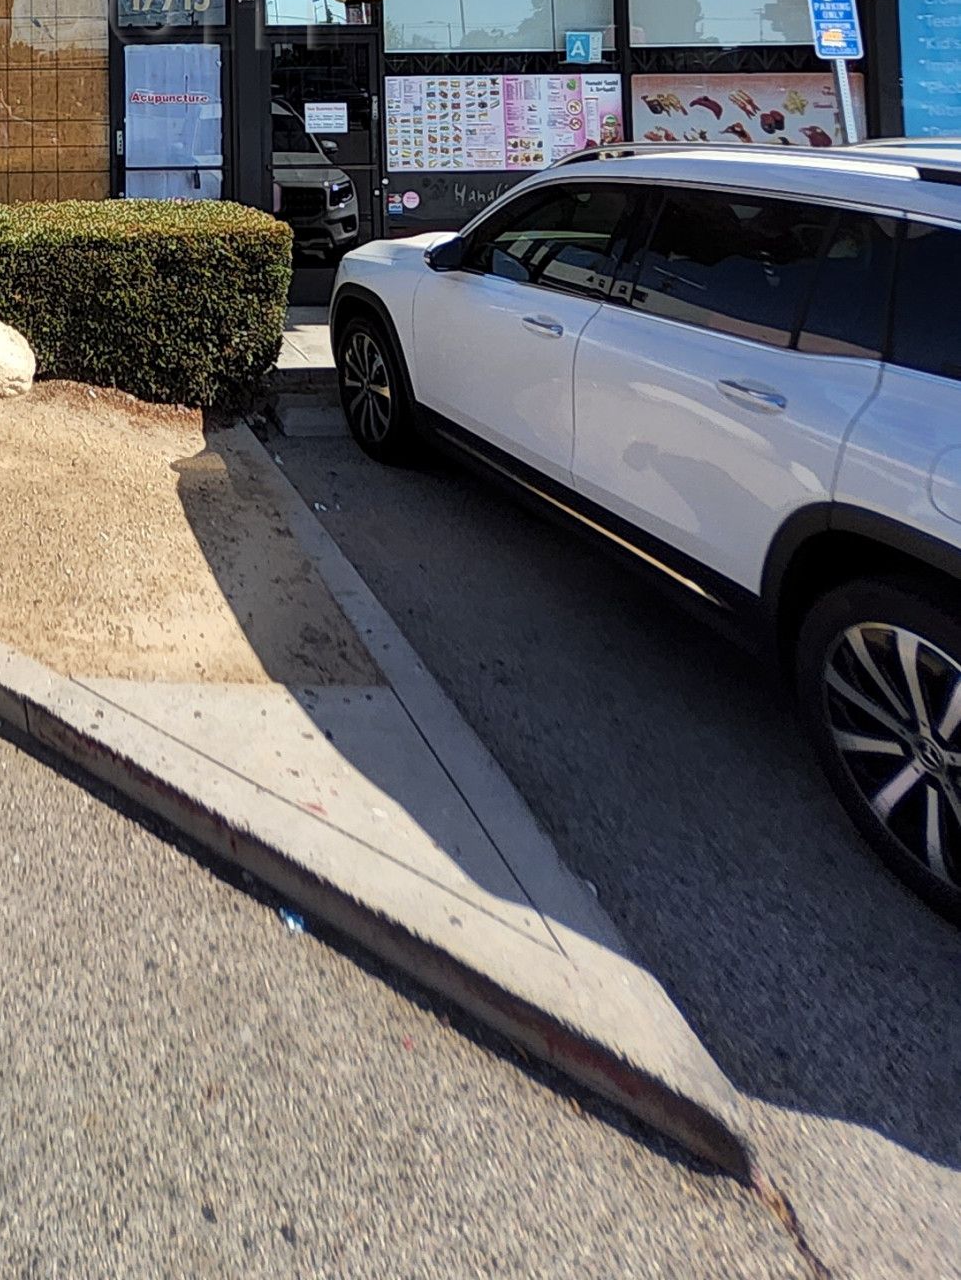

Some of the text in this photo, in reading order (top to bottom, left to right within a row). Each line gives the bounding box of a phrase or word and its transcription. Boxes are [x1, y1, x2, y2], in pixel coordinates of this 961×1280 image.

[814, 2, 851, 11] PARKING
[570, 40, 586, 57] A
[130, 91, 209, 105] Acupuncture
[454, 183, 508, 207] Hana
